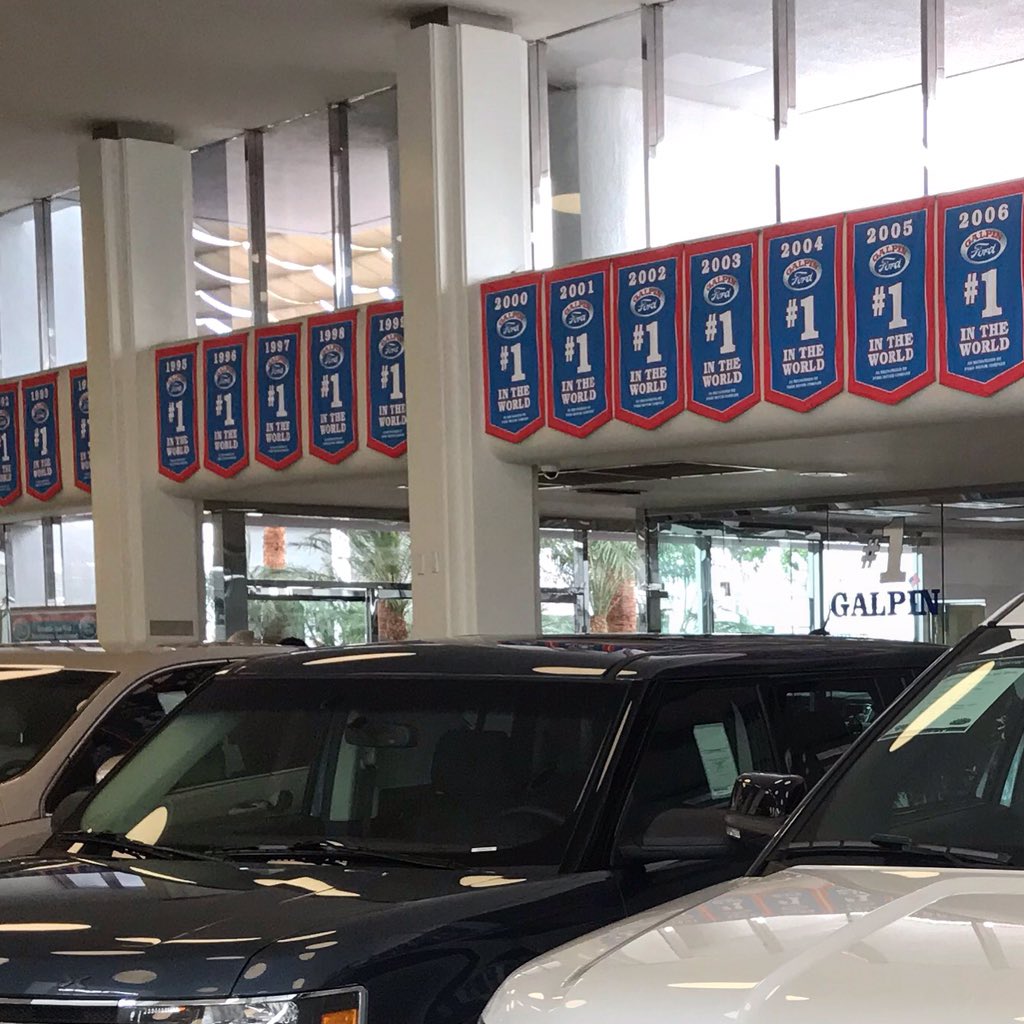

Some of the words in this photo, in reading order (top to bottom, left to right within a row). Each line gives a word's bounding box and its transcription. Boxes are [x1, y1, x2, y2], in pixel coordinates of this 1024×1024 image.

[959, 204, 1009, 229] 2006
[867, 219, 913, 243] 2005
[964, 230, 1006, 247] GALPIN
[781, 236, 823, 258] 2004
[872, 244, 910, 262] GALPIN
[971, 242, 996, 259] Ford
[702, 253, 741, 274] 2003
[786, 258, 821, 276] GALPIN
[878, 256, 902, 272] Ford
[629, 266, 666, 286] 2002
[560, 280, 594, 299] 2001
[964, 269, 1002, 318] #1
[495, 292, 528, 310] 2000
[872, 282, 907, 329] #1
[786, 296, 819, 340] #1
[320, 327, 344, 342] 1998
[705, 311, 736, 354] #1
[960, 327, 977, 341] IN
[980, 322, 1009, 338] THE
[265, 340, 290, 354] 1997
[633, 321, 662, 363] #1
[868, 337, 884, 352] IN
[886, 333, 914, 348] THE
[959, 338, 1010, 357] WORLD
[214, 350, 236, 364] 1996
[565, 333, 592, 373] #1
[783, 348, 796, 362] IN
[800, 344, 824, 359] THE
[868, 348, 914, 366] WORLD
[166, 358, 187, 372] 1995
[500, 343, 525, 382] #1
[704, 360, 717, 374] IN
[720, 358, 741, 371] THE
[782, 358, 824, 376] WORLD
[381, 363, 403, 400] #1
[630, 370, 642, 382] IN
[646, 366, 666, 380] THE
[703, 370, 742, 388] WORLD
[321, 373, 342, 408] #1
[498, 389, 508, 400] IN
[511, 384, 530, 398] THE
[562, 380, 573, 392] IN
[576, 377, 595, 390] THE
[630, 380, 667, 396] WORLD
[268, 384, 287, 417] #1
[498, 398, 530, 412] WORLD
[561, 389, 596, 404] WORLD
[168, 400, 185, 432] #1
[216, 393, 234, 426] #1
[330, 412, 346, 422] THE
[277, 421, 290, 431] THE
[320, 423, 346, 435] WORLD
[214, 440, 238, 450] WORLD
[266, 432, 290, 442] WORLD
[166, 446, 190, 456] WORLD
[861, 516, 906, 583] #1
[831, 589, 940, 616] GALPIN
